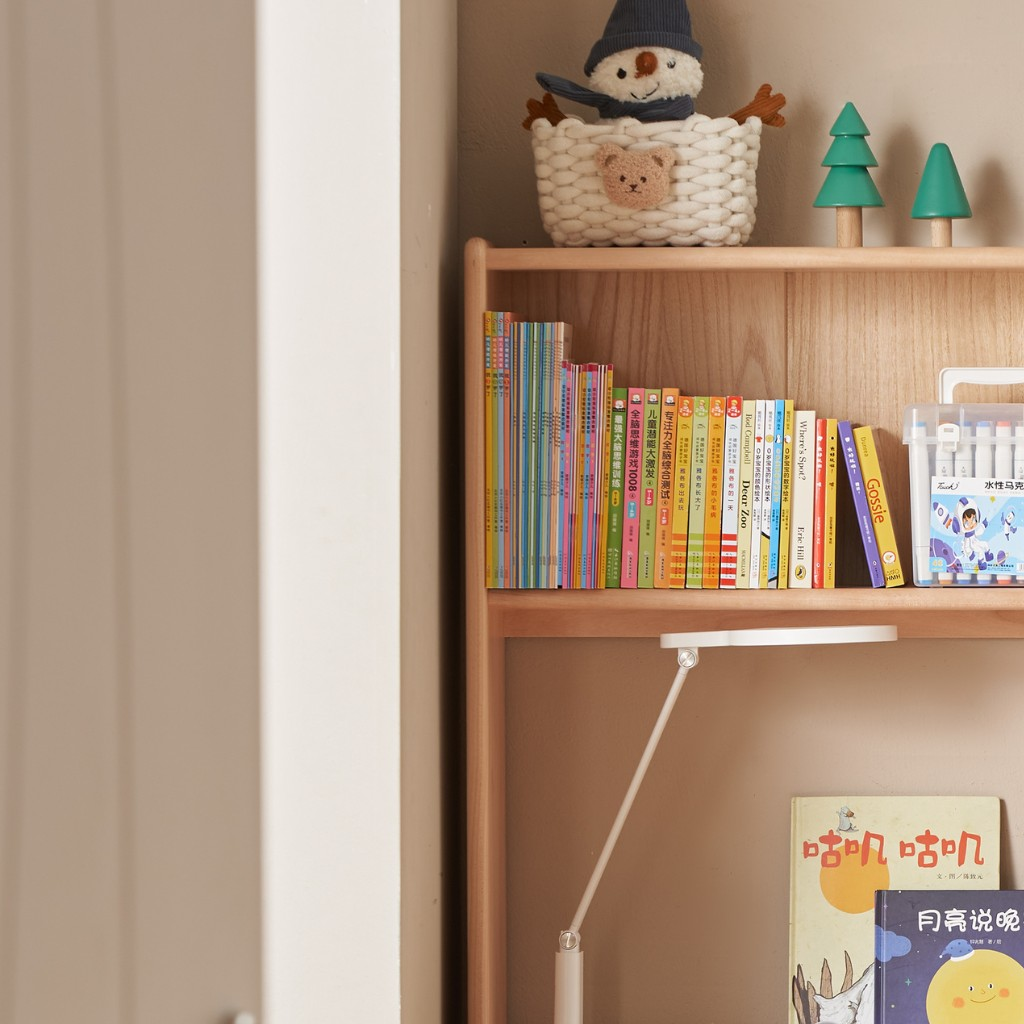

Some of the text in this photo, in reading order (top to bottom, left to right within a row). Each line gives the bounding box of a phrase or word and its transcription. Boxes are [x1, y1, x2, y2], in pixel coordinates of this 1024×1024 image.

[612, 415, 623, 488] 最强大脑思维训练
[628, 409, 641, 491] 全脑思维游戏1008
[645, 410, 658, 478] 儿童潜能大激发
[661, 411, 674, 499] 专注力全脑综合测试
[743, 413, 753, 464] Rod Campbell
[796, 421, 807, 480] Where's Spot?
[740, 480, 751, 529] Dear Zoo
[866, 478, 887, 524] Gossie
[797, 527, 805, 544] Eric
